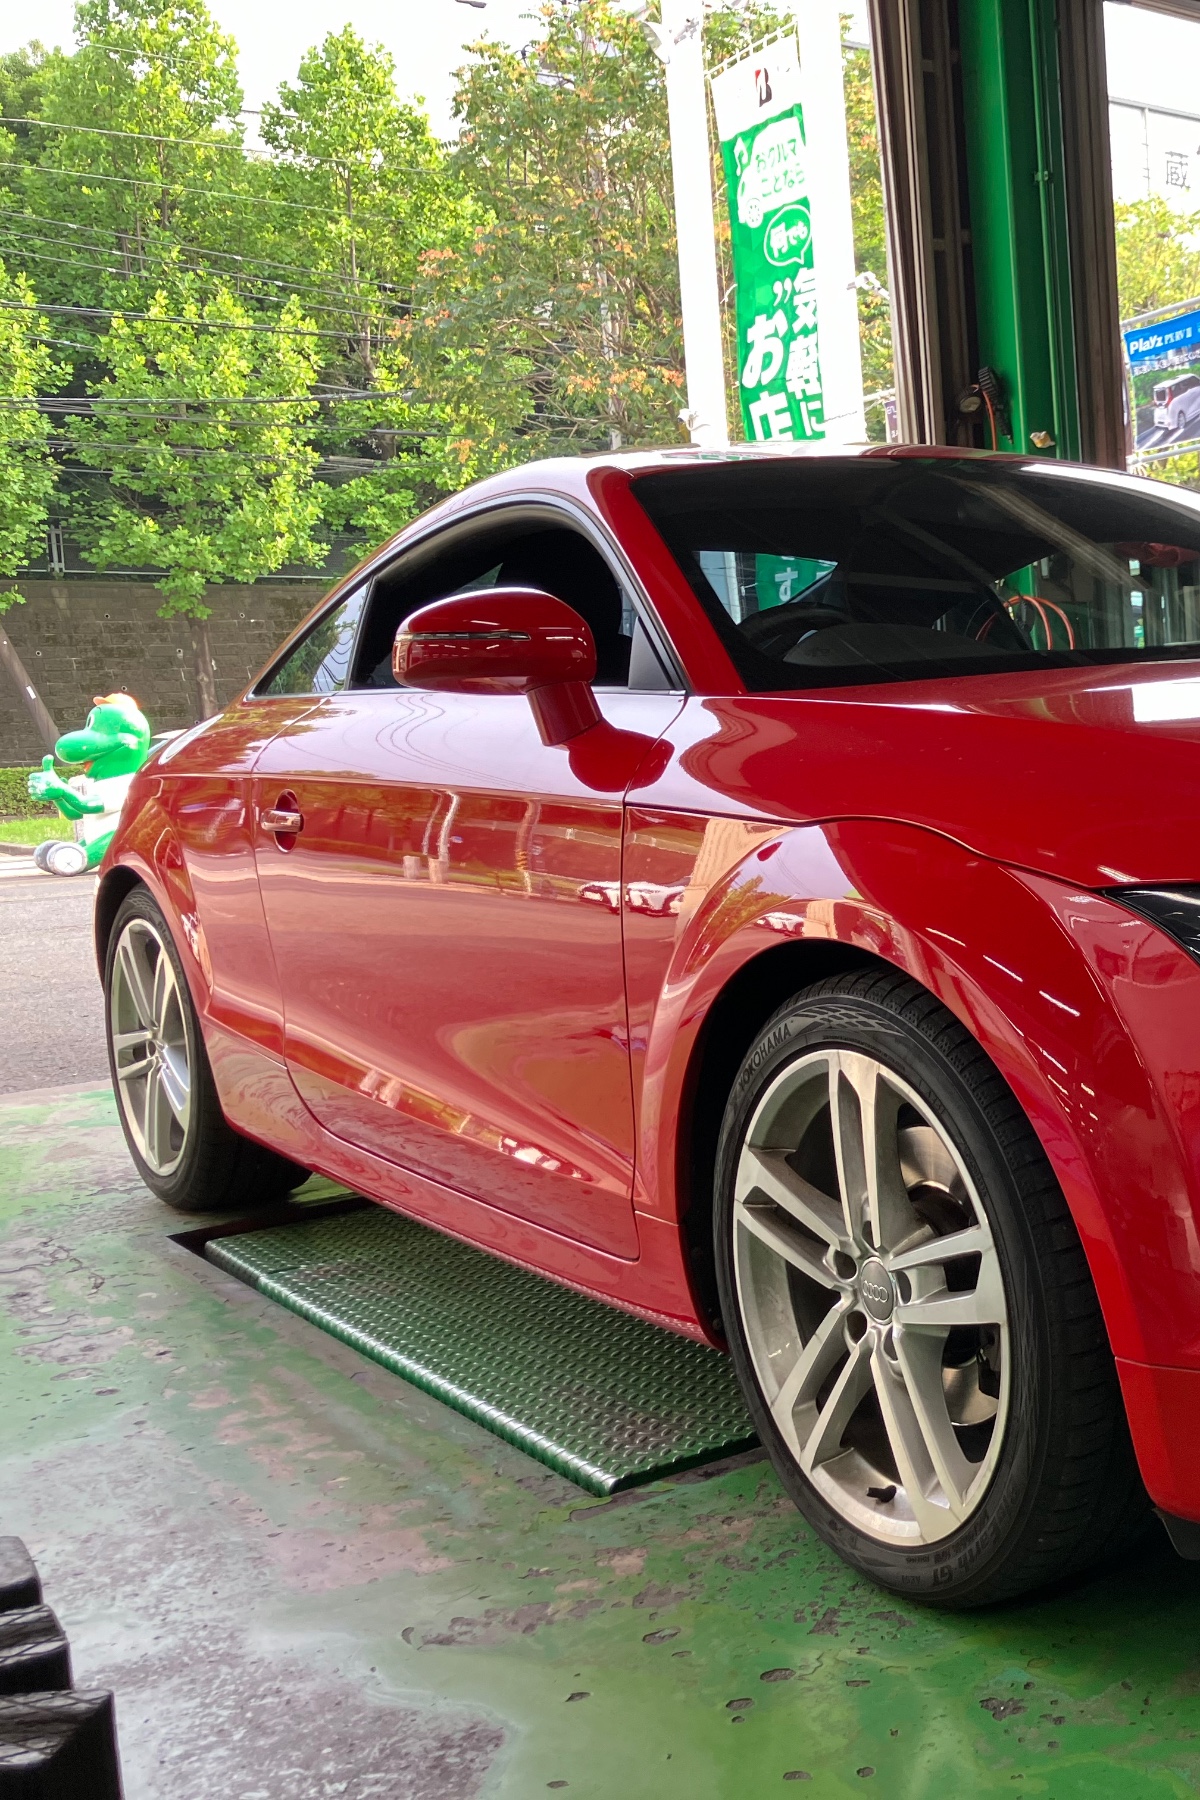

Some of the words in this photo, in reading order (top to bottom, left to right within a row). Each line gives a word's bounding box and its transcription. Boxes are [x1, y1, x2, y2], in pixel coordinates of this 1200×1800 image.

[769, 221, 809, 258] 何でも
[738, 1022, 792, 1092] YOKOHAMA
